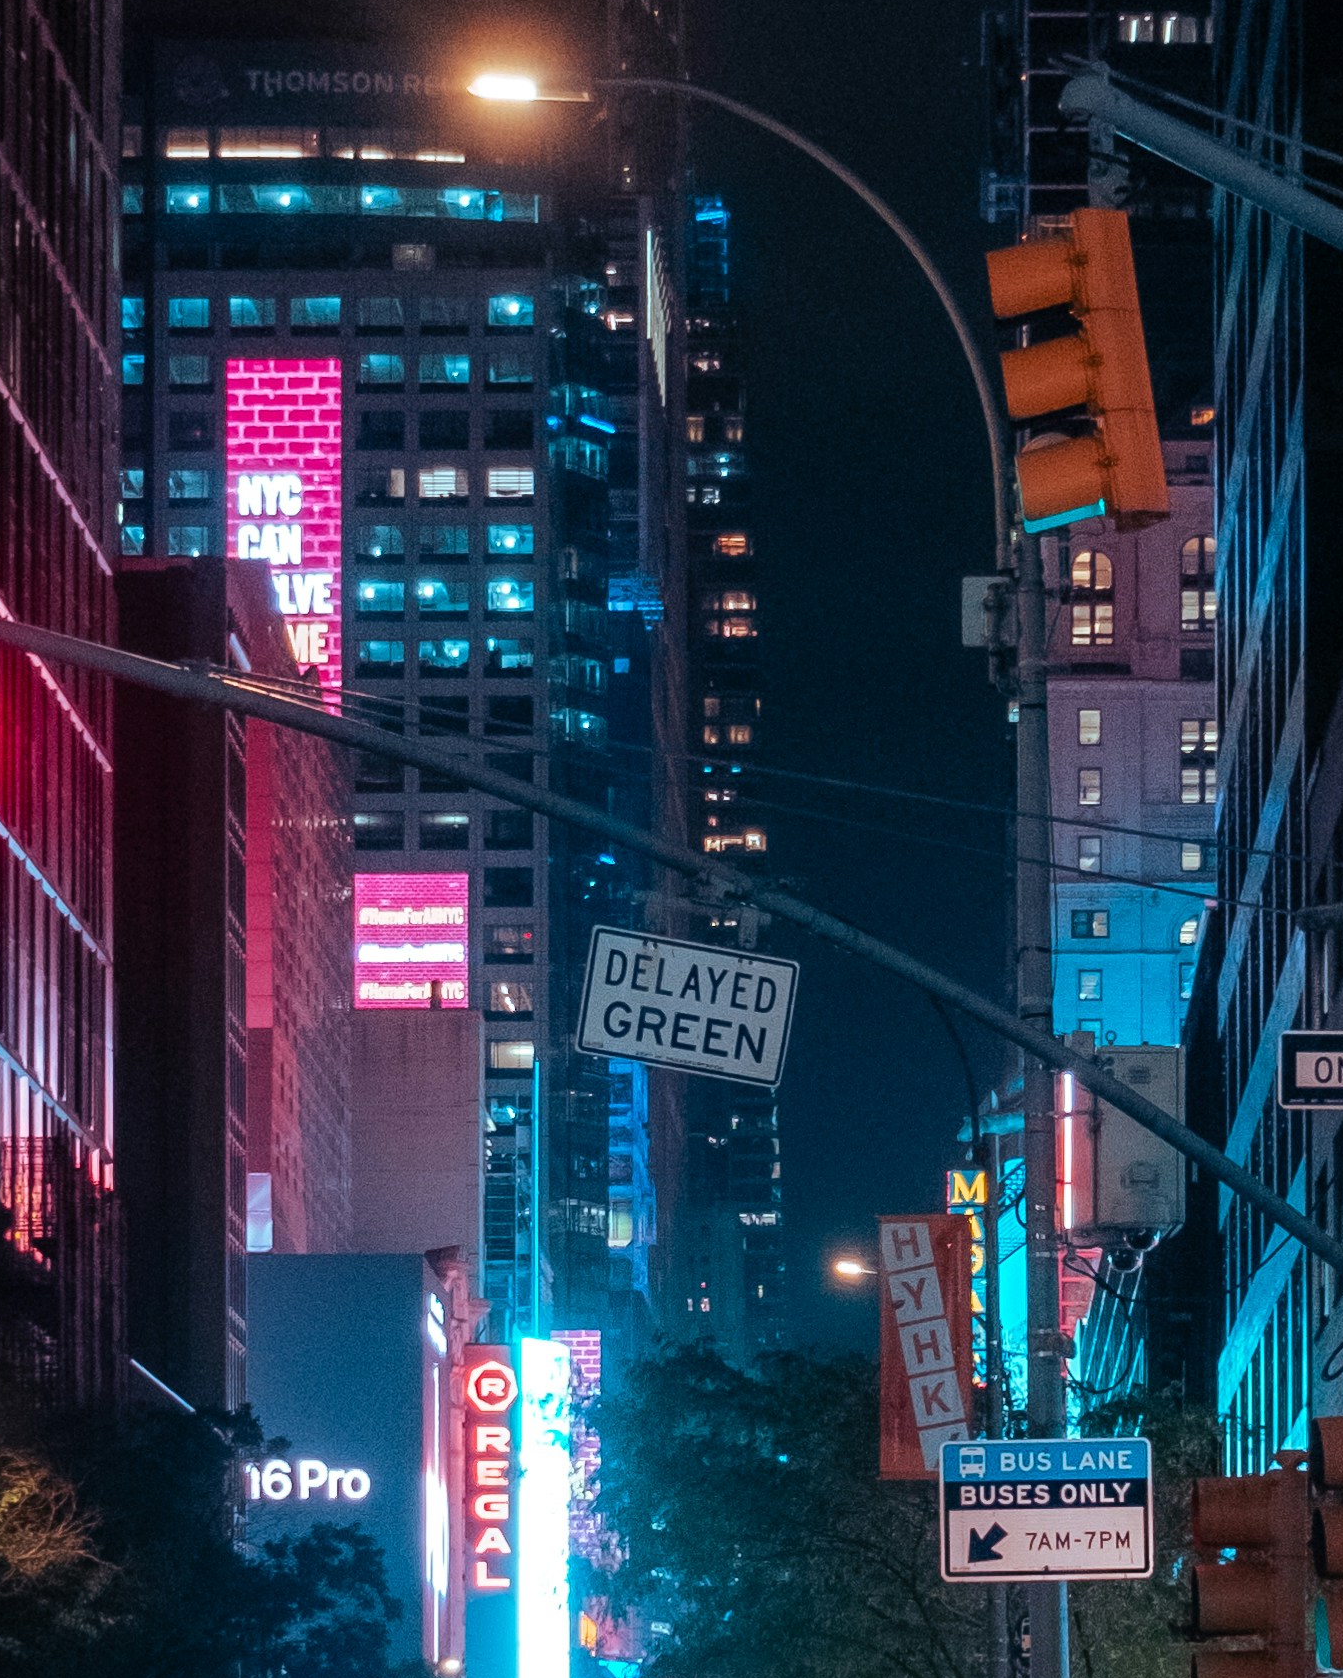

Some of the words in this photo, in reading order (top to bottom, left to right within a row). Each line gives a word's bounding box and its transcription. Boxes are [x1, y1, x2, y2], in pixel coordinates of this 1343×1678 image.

[248, 71, 394, 97] THOMSON
[238, 475, 302, 516] NYC
[238, 524, 302, 565] CAN
[605, 949, 777, 1013] DELAYED
[603, 1001, 767, 1064] GREEN
[245, 1459, 293, 1500] 16
[299, 1459, 371, 1500] Pro
[999, 1452, 1051, 1472] BUS
[1062, 1450, 1133, 1471] LANE
[474, 1425, 511, 1588] REGAL
[960, 1484, 1050, 1506] BUSES
[1060, 1482, 1131, 1505] ONLY
[1025, 1530, 1130, 1552] 7AM-7PM
